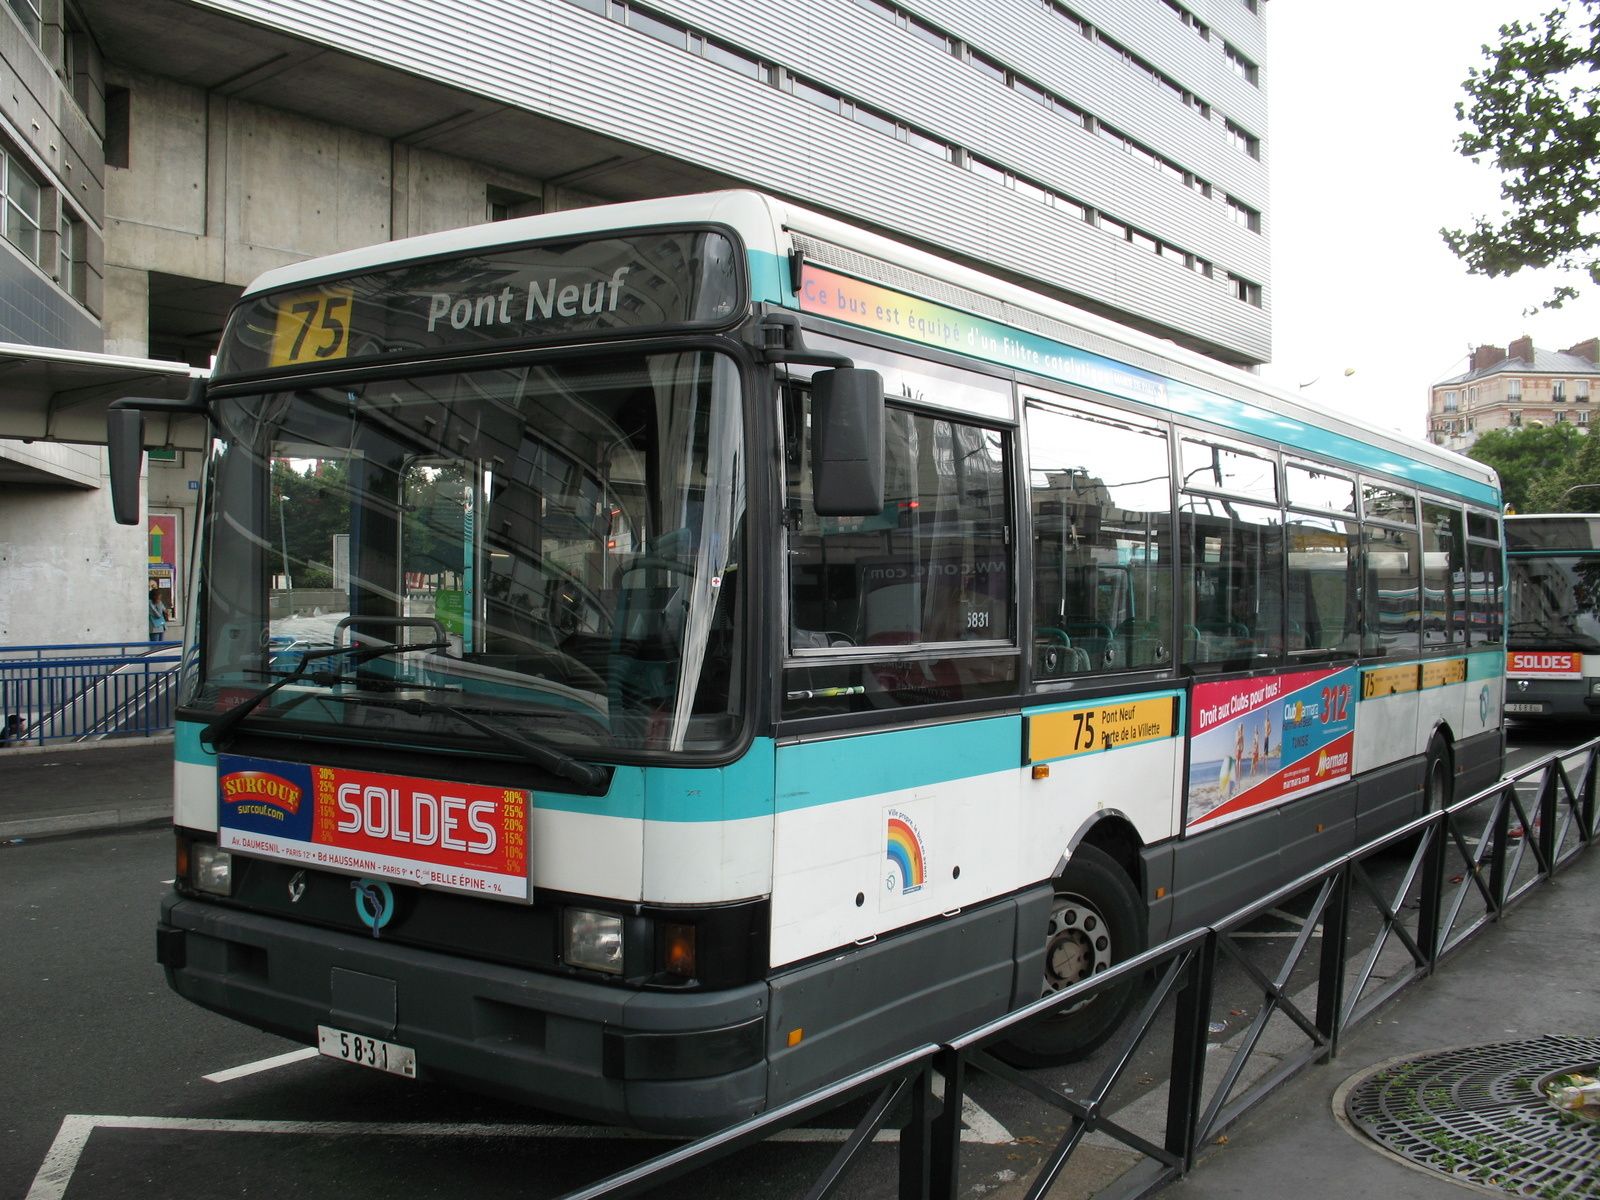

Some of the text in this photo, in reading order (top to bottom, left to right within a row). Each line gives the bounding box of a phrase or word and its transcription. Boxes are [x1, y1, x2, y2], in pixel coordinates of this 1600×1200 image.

[426, 266, 630, 334] Pont Neuf
[804, 280, 827, 305] Ce
[838, 288, 867, 315] bus
[876, 304, 900, 326] est
[908, 309, 960, 344] équipé
[967, 327, 997, 349] d'un
[288, 297, 347, 361] 75
[967, 611, 989, 628] 5831
[1513, 655, 1572, 669] SOLDES
[1365, 673, 1375, 697] 75
[1102, 705, 1136, 725] Pont Neuf
[1200, 704, 1218, 729] Droit
[1218, 702, 1230, 720] aux
[1230, 692, 1249, 714] Clubs
[1249, 688, 1265, 710] pour
[1265, 682, 1278, 699] tous
[1284, 702, 1297, 721] Club
[1073, 712, 1095, 750] 75
[1101, 723, 1160, 745] Porte de la Villette
[225, 776, 300, 807] SURCOUF
[237, 805, 285, 821] surcouf.com
[337, 782, 497, 855] SOLDES
[888, 808, 899, 817] Ville
[231, 837, 241, 847] Av.
[242, 838, 280, 854] DAUMESNIL
[285, 847, 302, 858] PARIS
[317, 852, 327, 862] Bd
[329, 854, 376, 870] HAUSSMANN
[382, 865, 400, 875] PARIS
[430, 871, 457, 885] BELLE
[459, 873, 485, 889] ÉPINE
[493, 883, 502, 892] 94
[340, 1033, 388, 1070] 5831
